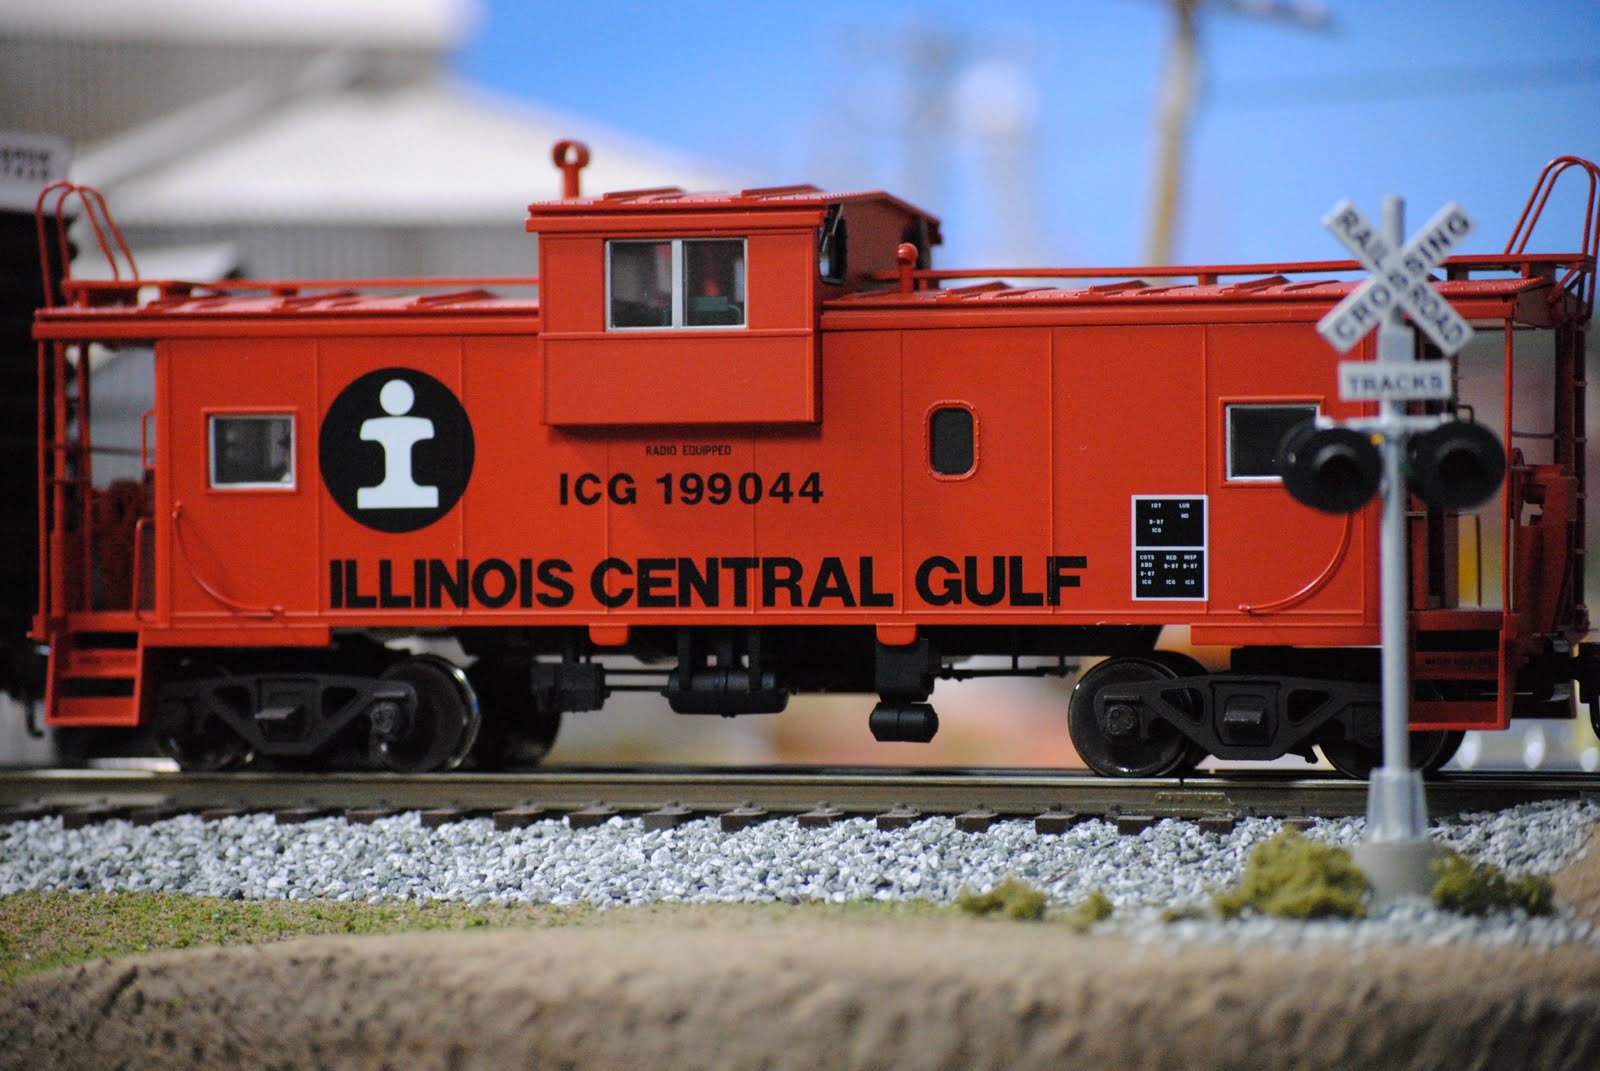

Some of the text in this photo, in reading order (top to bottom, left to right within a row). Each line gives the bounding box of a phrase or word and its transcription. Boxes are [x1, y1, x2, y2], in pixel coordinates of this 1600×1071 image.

[1334, 210, 1470, 340] CROSSING
[1410, 284, 1464, 342] ROAD
[1350, 375, 1443, 393] TRACKS
[645, 445, 732, 456] RADIO EQUIPPED
[560, 472, 823, 505] ICG 199044
[329, 556, 1088, 610] ILLINOIS CENTRAL GULF
